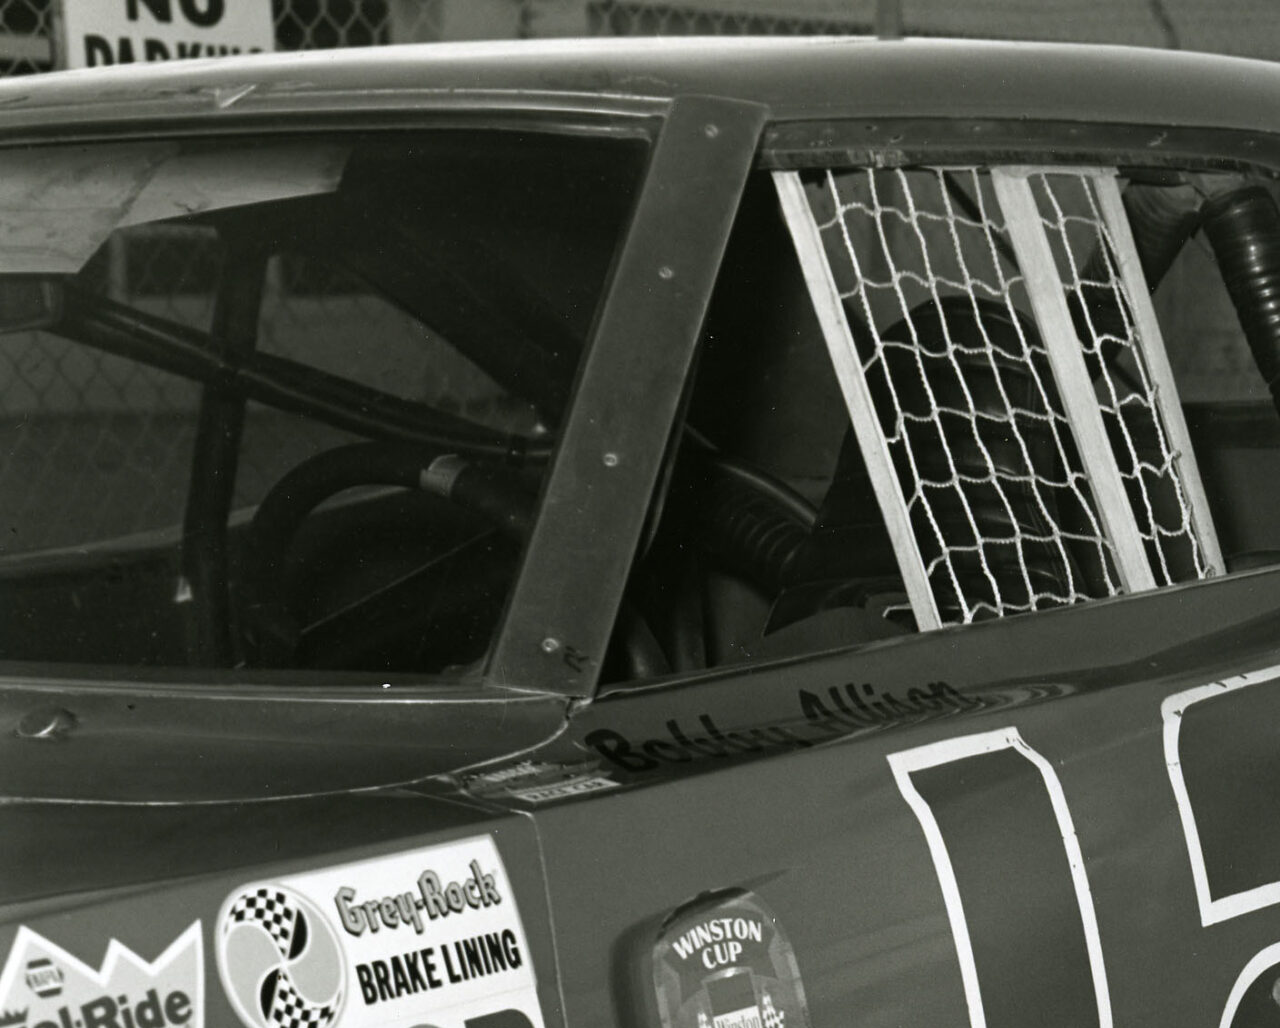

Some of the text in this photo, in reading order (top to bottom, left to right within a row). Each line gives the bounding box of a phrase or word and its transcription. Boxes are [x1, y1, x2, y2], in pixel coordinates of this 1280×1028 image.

[334, 858, 502, 937] Grey-Rock
[355, 928, 523, 1006] BRAKE LINING
[672, 918, 762, 960] WINSTON
[702, 941, 743, 969] CUP
